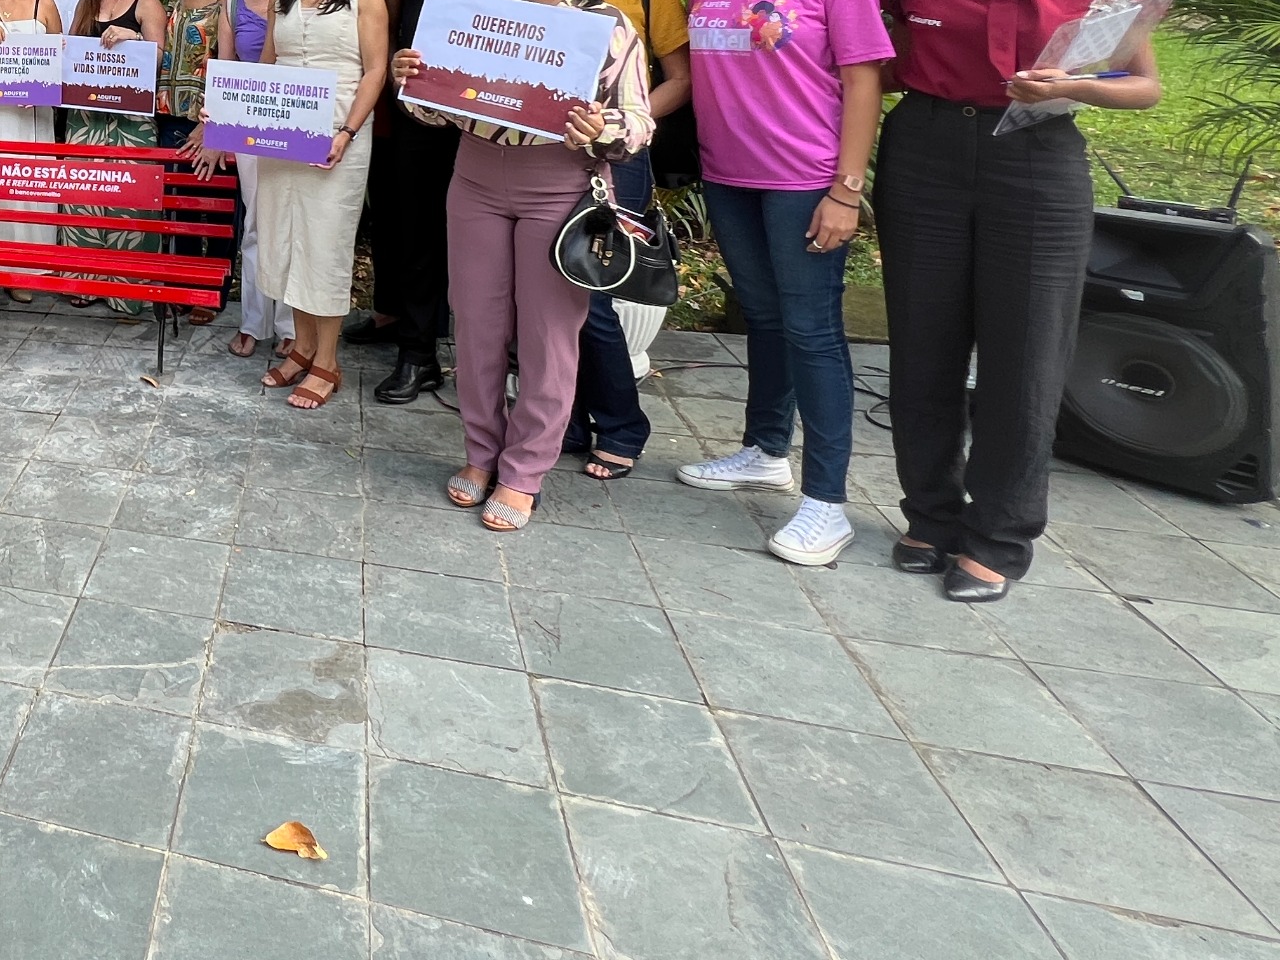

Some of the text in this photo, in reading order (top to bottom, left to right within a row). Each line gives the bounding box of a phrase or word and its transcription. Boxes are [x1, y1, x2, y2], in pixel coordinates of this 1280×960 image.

[472, 14, 546, 41] QUEREMOS
[708, 18, 727, 27] da
[691, 29, 746, 48] ulher
[12, 47, 20, 55] SE
[23, 47, 57, 56] COMBATE
[448, 30, 566, 67] CONTINUAR VIVAS
[22, 57, 50, 66] DENÚNCIA
[85, 52, 126, 64] AS NOSSAS
[0, 66, 29, 76] PROTEÇÃO
[74, 63, 139, 78] VIDAS IMPORTAM
[212, 77, 329, 99] FEMINICÍDIO SE COMBATE
[222, 91, 318, 110] COM CORAGEM, DENÚNCIA
[477, 91, 524, 108] ADUFEPE
[246, 106, 290, 121] E PROTEÇÃO
[256, 138, 288, 148] ADUFEPE
[2, 163, 32, 177] NÃO
[34, 165, 67, 180] ESTÁ
[69, 168, 136, 183] SOZINHA.
[12, 179, 48, 188] REFLETIR.
[49, 182, 91, 191] LEVANTAR
[99, 184, 121, 193] AGIR.
